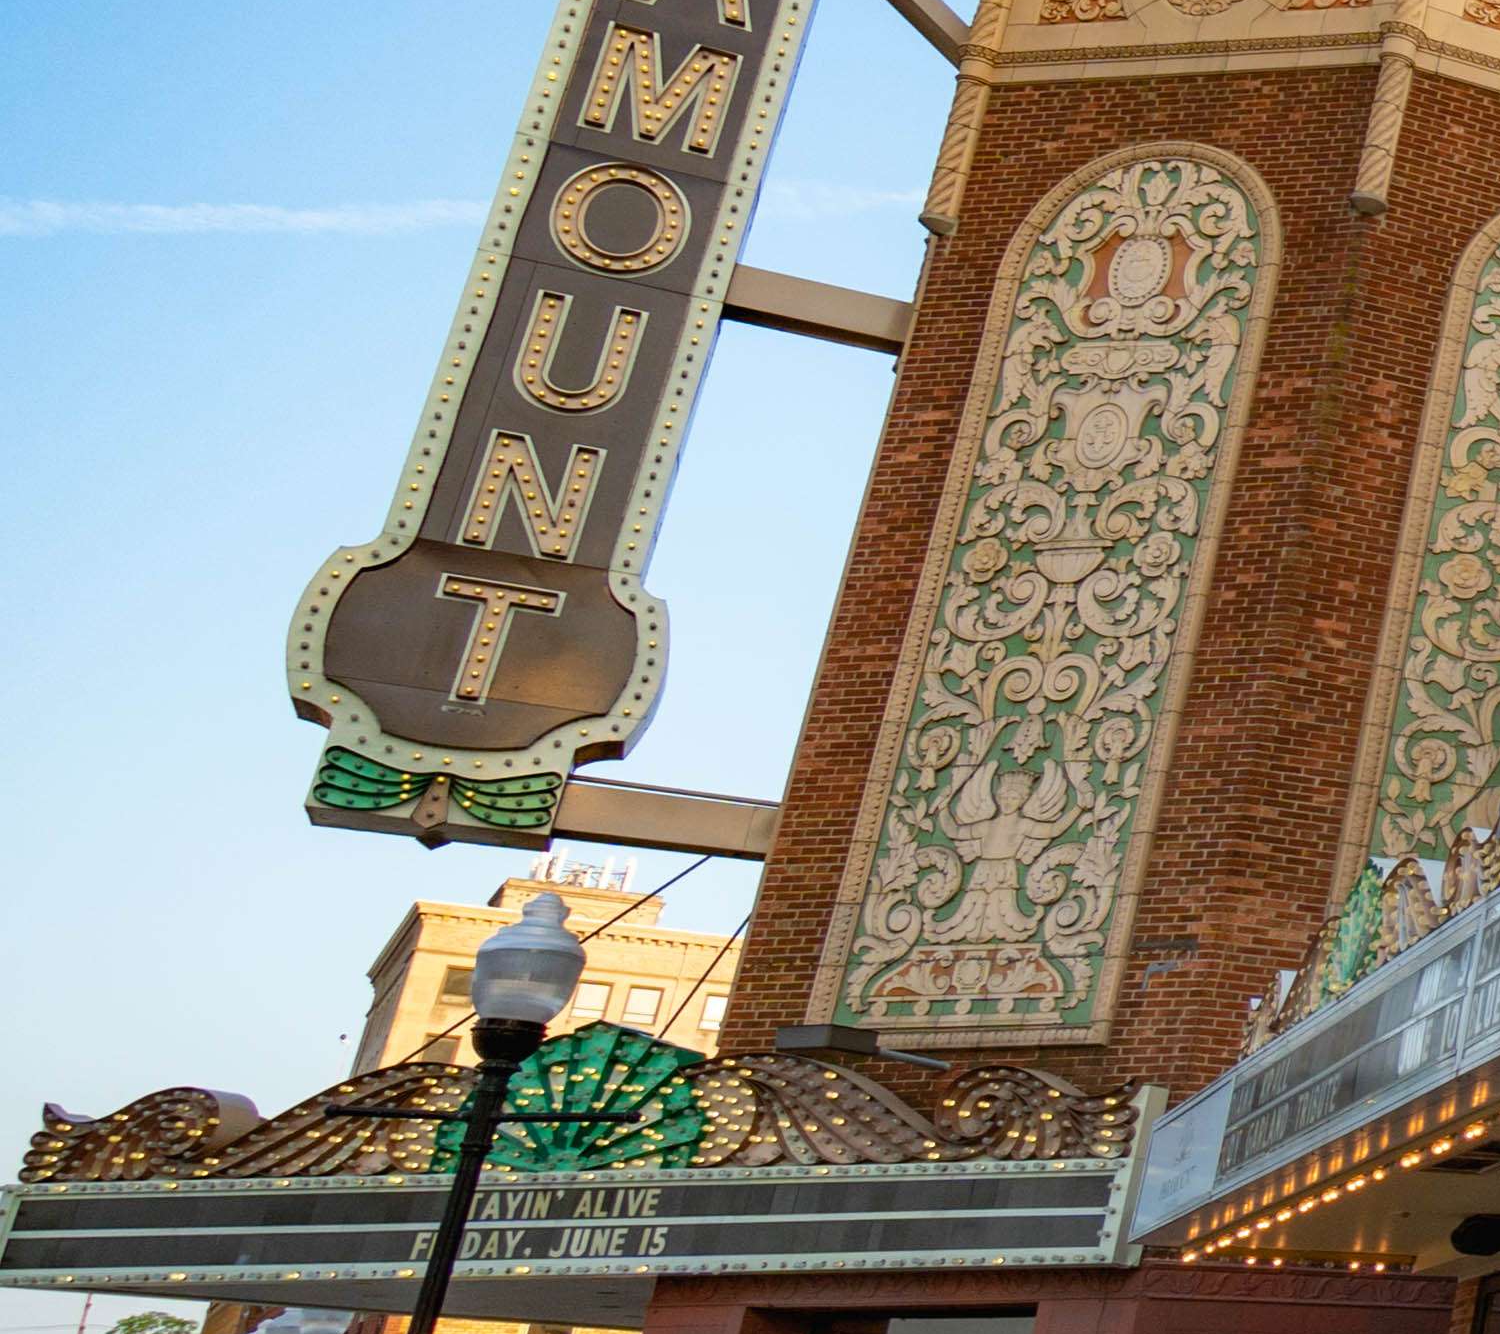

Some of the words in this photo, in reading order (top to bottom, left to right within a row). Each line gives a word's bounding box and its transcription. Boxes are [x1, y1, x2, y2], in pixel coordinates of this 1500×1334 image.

[468, 1189, 564, 1220] TAYIN'
[573, 1188, 662, 1218] ALIVE
[409, 1228, 532, 1260] FDAY,
[548, 1228, 629, 1258] JUNE
[637, 1226, 669, 1256] 15
